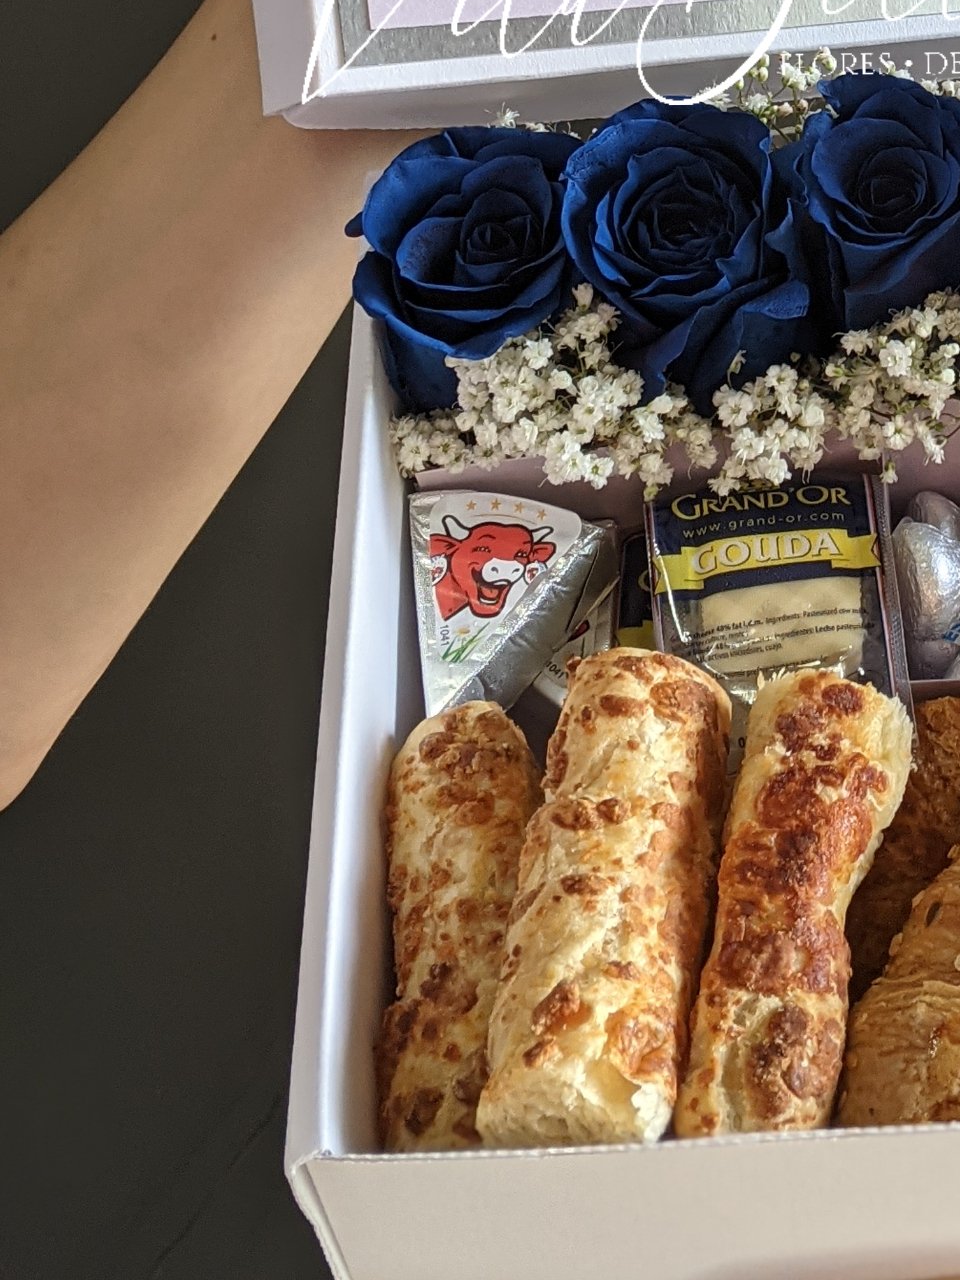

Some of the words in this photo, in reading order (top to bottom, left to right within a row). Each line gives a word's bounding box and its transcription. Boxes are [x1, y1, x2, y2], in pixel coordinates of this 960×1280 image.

[682, 510, 845, 539] www.grand-or.com
[691, 530, 844, 575] GOUDA
[439, 624, 450, 646] 1041
